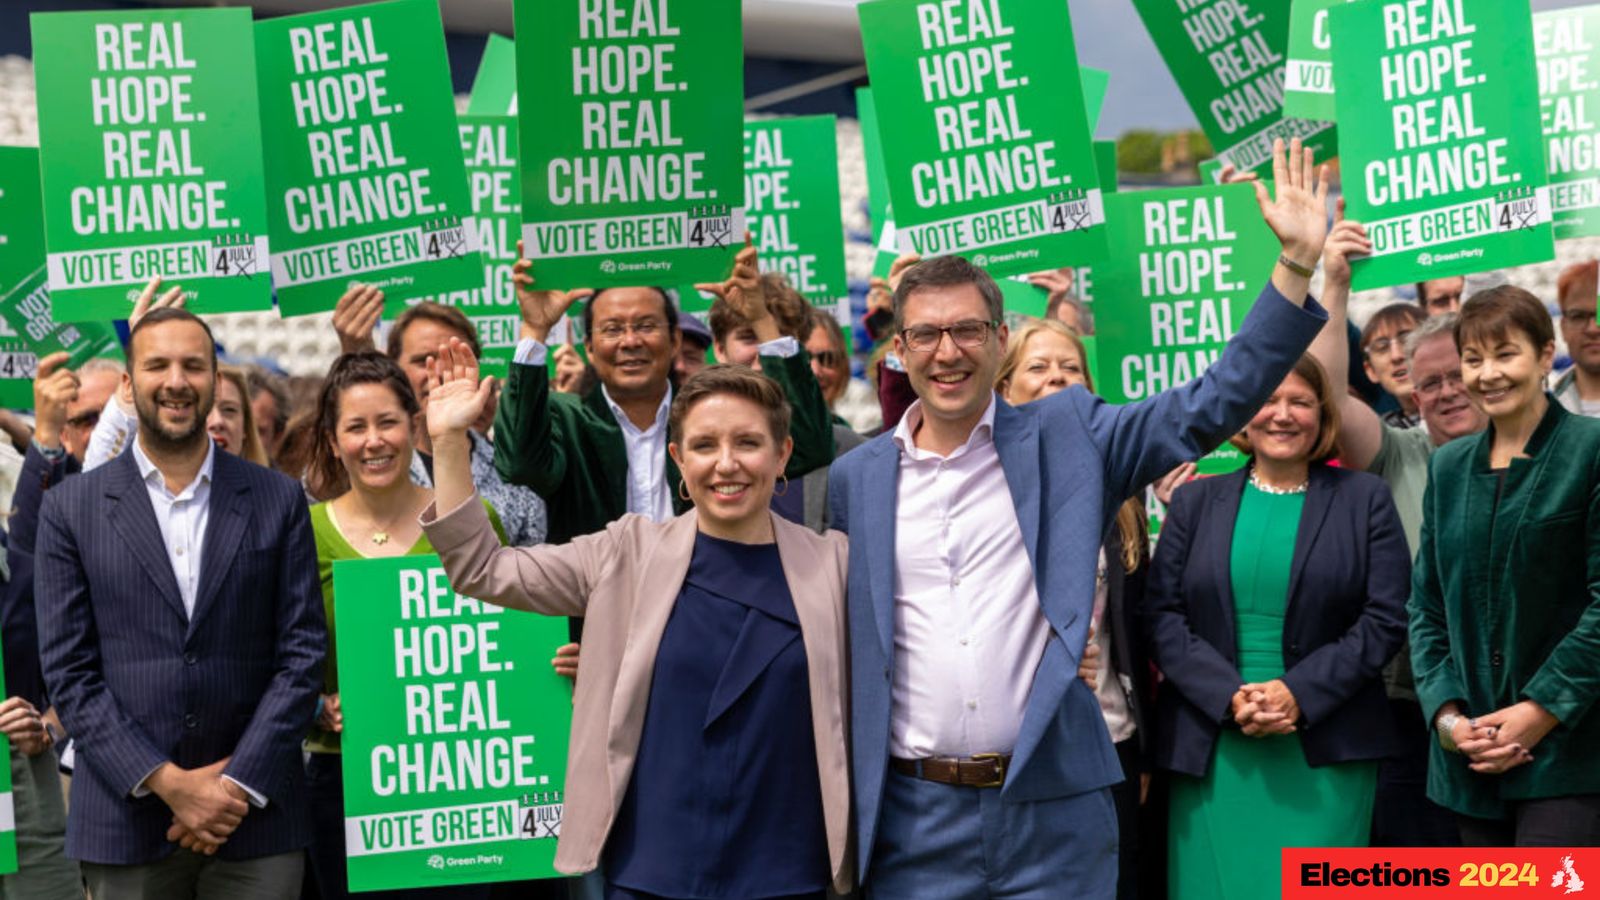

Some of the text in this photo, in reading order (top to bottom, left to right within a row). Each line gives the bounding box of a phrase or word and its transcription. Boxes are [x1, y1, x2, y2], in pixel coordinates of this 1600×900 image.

[579, 0, 680, 39] REAL
[917, 0, 1014, 50] REAL
[1183, 0, 1265, 53] HOPE.
[1383, 0, 1476, 49] REAL
[1533, 15, 1593, 55] EAL
[96, 22, 196, 71] REAL
[289, 17, 388, 74] REAL
[1208, 30, 1282, 88] REAL
[572, 44, 688, 95] HOPE.
[918, 42, 1029, 102] HOPE.
[1300, 64, 1332, 89] VOT
[1381, 40, 1487, 101] HOPE.
[1537, 55, 1598, 95] PE.
[91, 75, 206, 125] HOPE.
[291, 69, 403, 128] HOPE.
[1392, 92, 1486, 150] REAL
[1541, 95, 1595, 135] EAL
[458, 125, 516, 167] EAL
[582, 99, 683, 150] REAL
[934, 94, 1032, 152] REAL
[103, 129, 204, 178] REAL
[307, 121, 406, 178] REAL
[744, 128, 792, 169] EAL
[1226, 136, 1272, 170] VOTE
[472, 171, 522, 213] PE.
[547, 152, 717, 206] CHANGE.
[744, 171, 800, 211] PE.
[911, 141, 1072, 208] CHANGE.
[1364, 138, 1521, 206] CHANGE.
[70, 181, 240, 235] CHANGE.
[284, 168, 446, 234] CHANGE.
[1053, 202, 1087, 231] 4 JULY
[1499, 199, 1534, 229] 4 JULY
[1549, 182, 1593, 210] EEN
[428, 228, 461, 258] 4 JULY
[479, 218, 516, 260] AL
[537, 216, 682, 254] VOTE GREEN
[690, 218, 729, 247] 4 JULY
[745, 214, 799, 252] EAL
[910, 205, 1045, 255] VOTE GREEN
[1143, 196, 1236, 246] REAL
[1420, 203, 1492, 242] GREEN
[62, 245, 207, 285] VOTE GREEN
[215, 246, 253, 275] 4 JULY
[283, 231, 420, 281] VOTE GREEN
[618, 260, 672, 272] Green Party
[989, 248, 1039, 263] Green Party
[1139, 247, 1245, 297] HOPE.
[1434, 248, 1485, 263] Green Party
[16, 283, 50, 320] VOT
[1150, 297, 1236, 347] REAL
[477, 318, 514, 344] EEN
[3, 355, 14, 378] 4
[1121, 351, 1221, 399] CHAN
[1215, 449, 1238, 459] Party
[400, 568, 504, 619] RE
[394, 621, 514, 678] HOPE.
[405, 679, 511, 735] REAL
[370, 735, 549, 797] CHANGE.
[360, 805, 513, 850] VOTE GREEN
[522, 805, 562, 837] 4 JULY
[447, 853, 503, 867] Green Party
